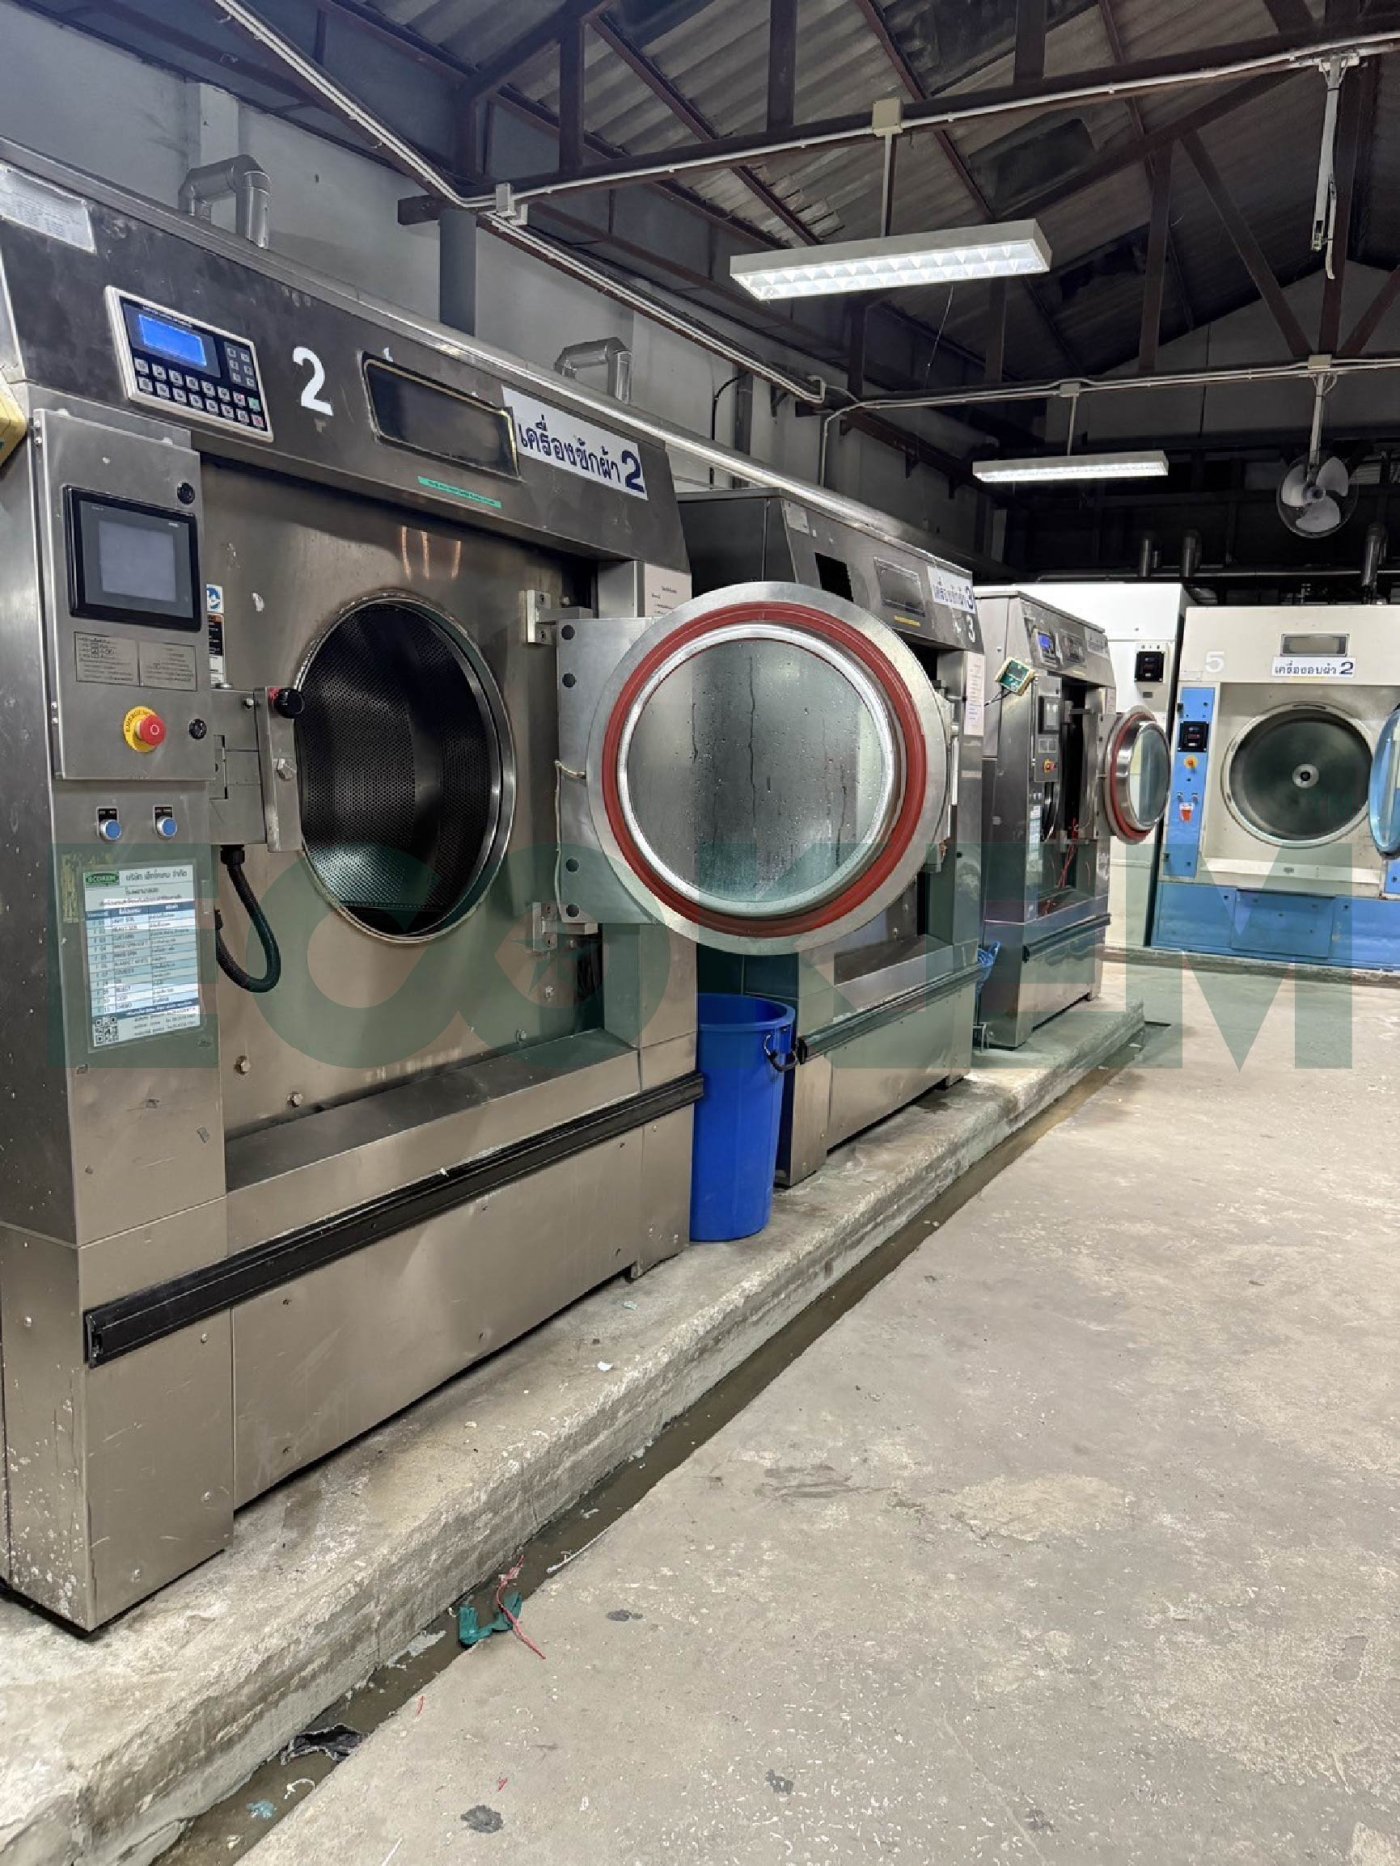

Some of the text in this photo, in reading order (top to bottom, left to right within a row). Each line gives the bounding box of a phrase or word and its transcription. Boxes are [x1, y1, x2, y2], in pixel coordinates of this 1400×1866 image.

[292, 346, 334, 416] 2
[622, 449, 646, 493] 2
[1204, 650, 1225, 673] 5
[1339, 661, 1354, 675] 2
